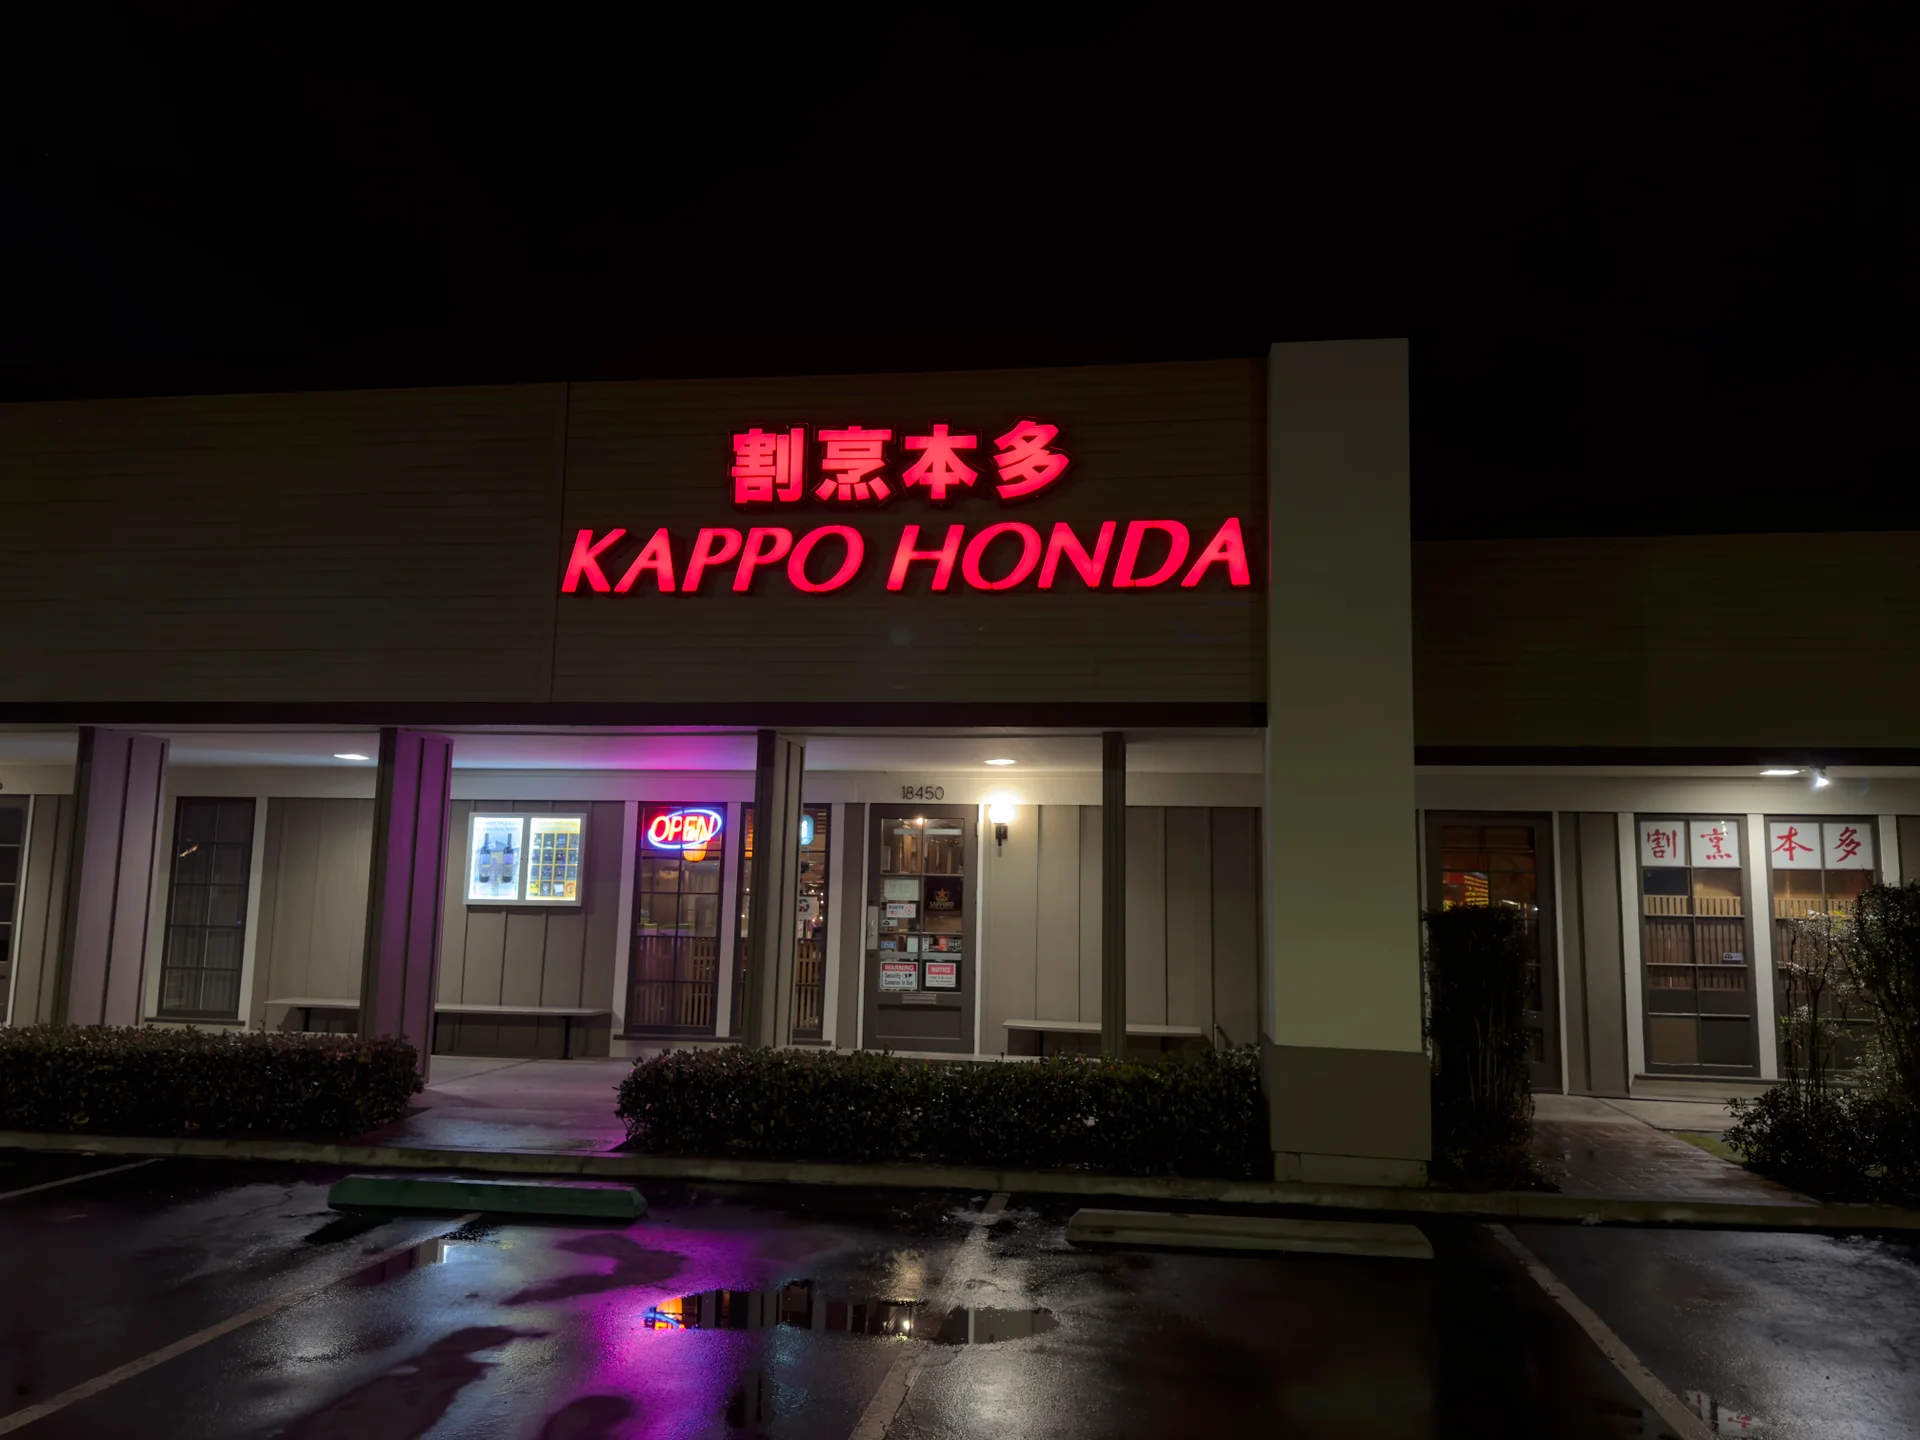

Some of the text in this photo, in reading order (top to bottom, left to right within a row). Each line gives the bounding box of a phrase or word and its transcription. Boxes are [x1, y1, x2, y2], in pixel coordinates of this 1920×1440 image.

[731, 420, 1069, 503] 割烹本多
[562, 518, 1250, 592] KAPPO HONDA
[901, 785, 945, 801] 18450
[650, 815, 716, 842] OPEN
[929, 901, 955, 909] SAPPORO
[884, 964, 914, 972] WARNING
[884, 972, 901, 980] Security
